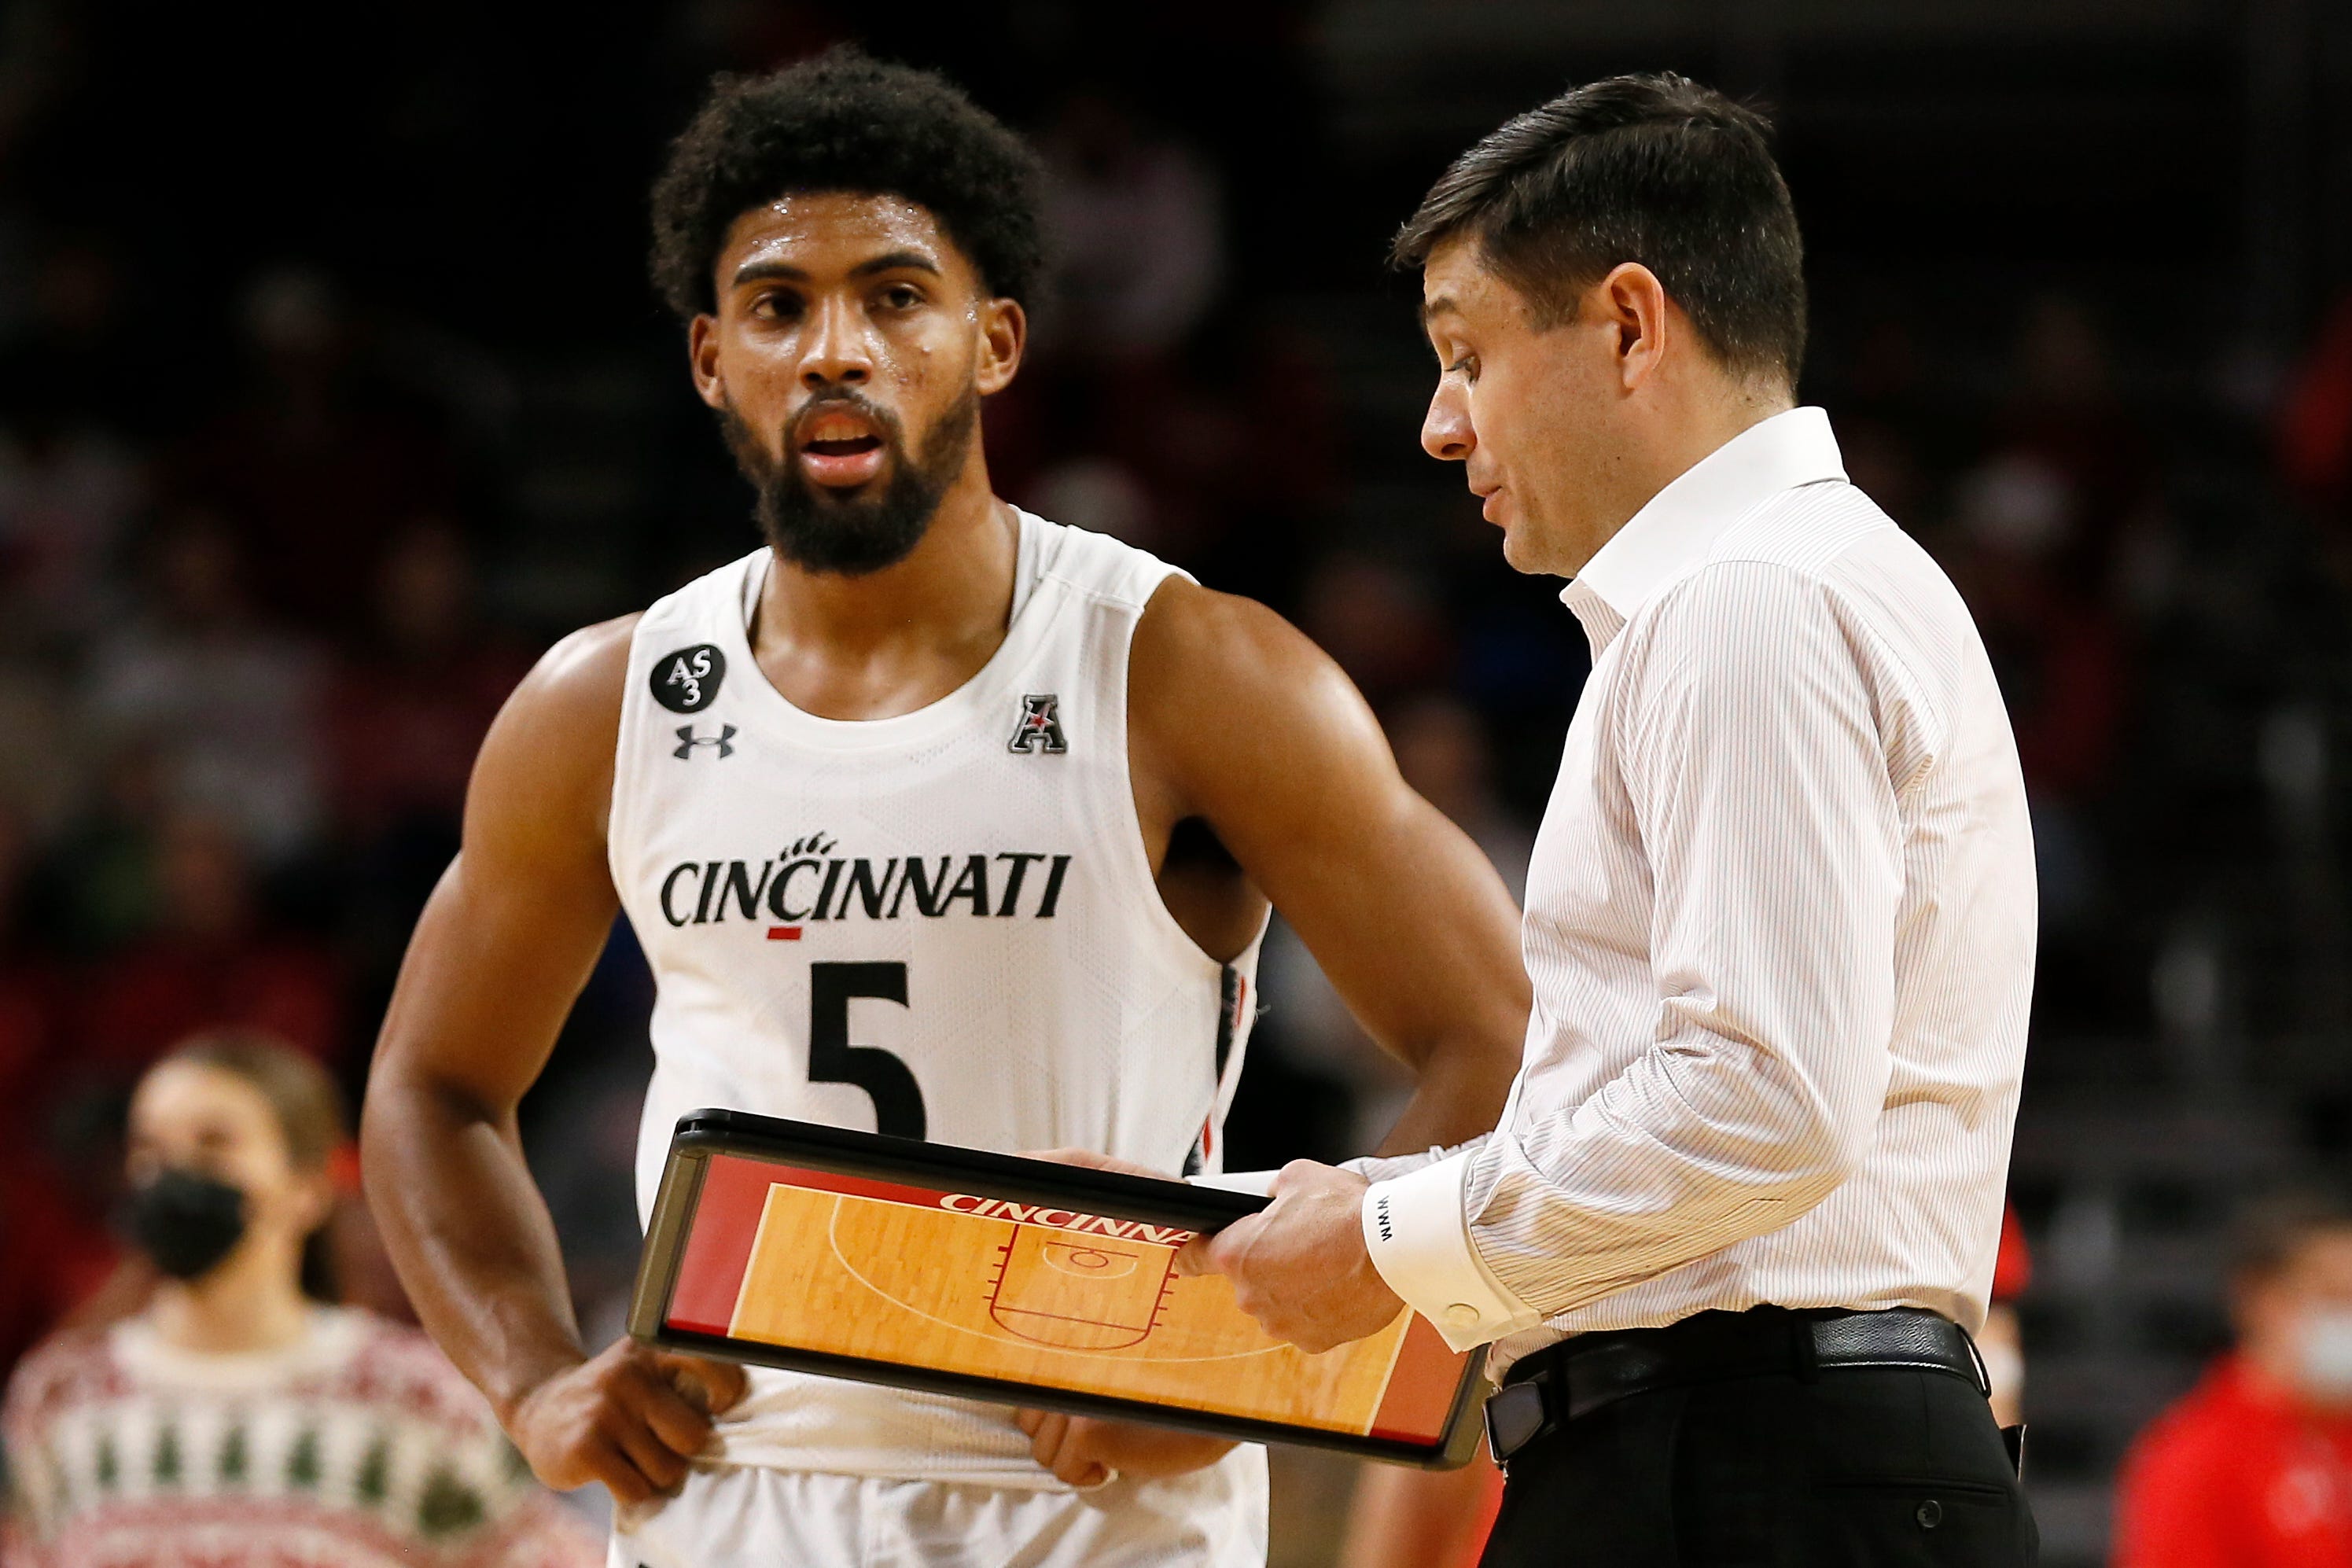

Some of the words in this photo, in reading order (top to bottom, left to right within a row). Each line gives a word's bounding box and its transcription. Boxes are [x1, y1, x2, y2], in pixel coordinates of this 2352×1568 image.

[667, 649, 711, 685] AS
[682, 679, 701, 706] 3
[1008, 694, 1068, 753] A
[661, 852, 1073, 928] CINCINNATI
[808, 962, 926, 1143] 5
[939, 1193, 1200, 1244] CINCINNA
